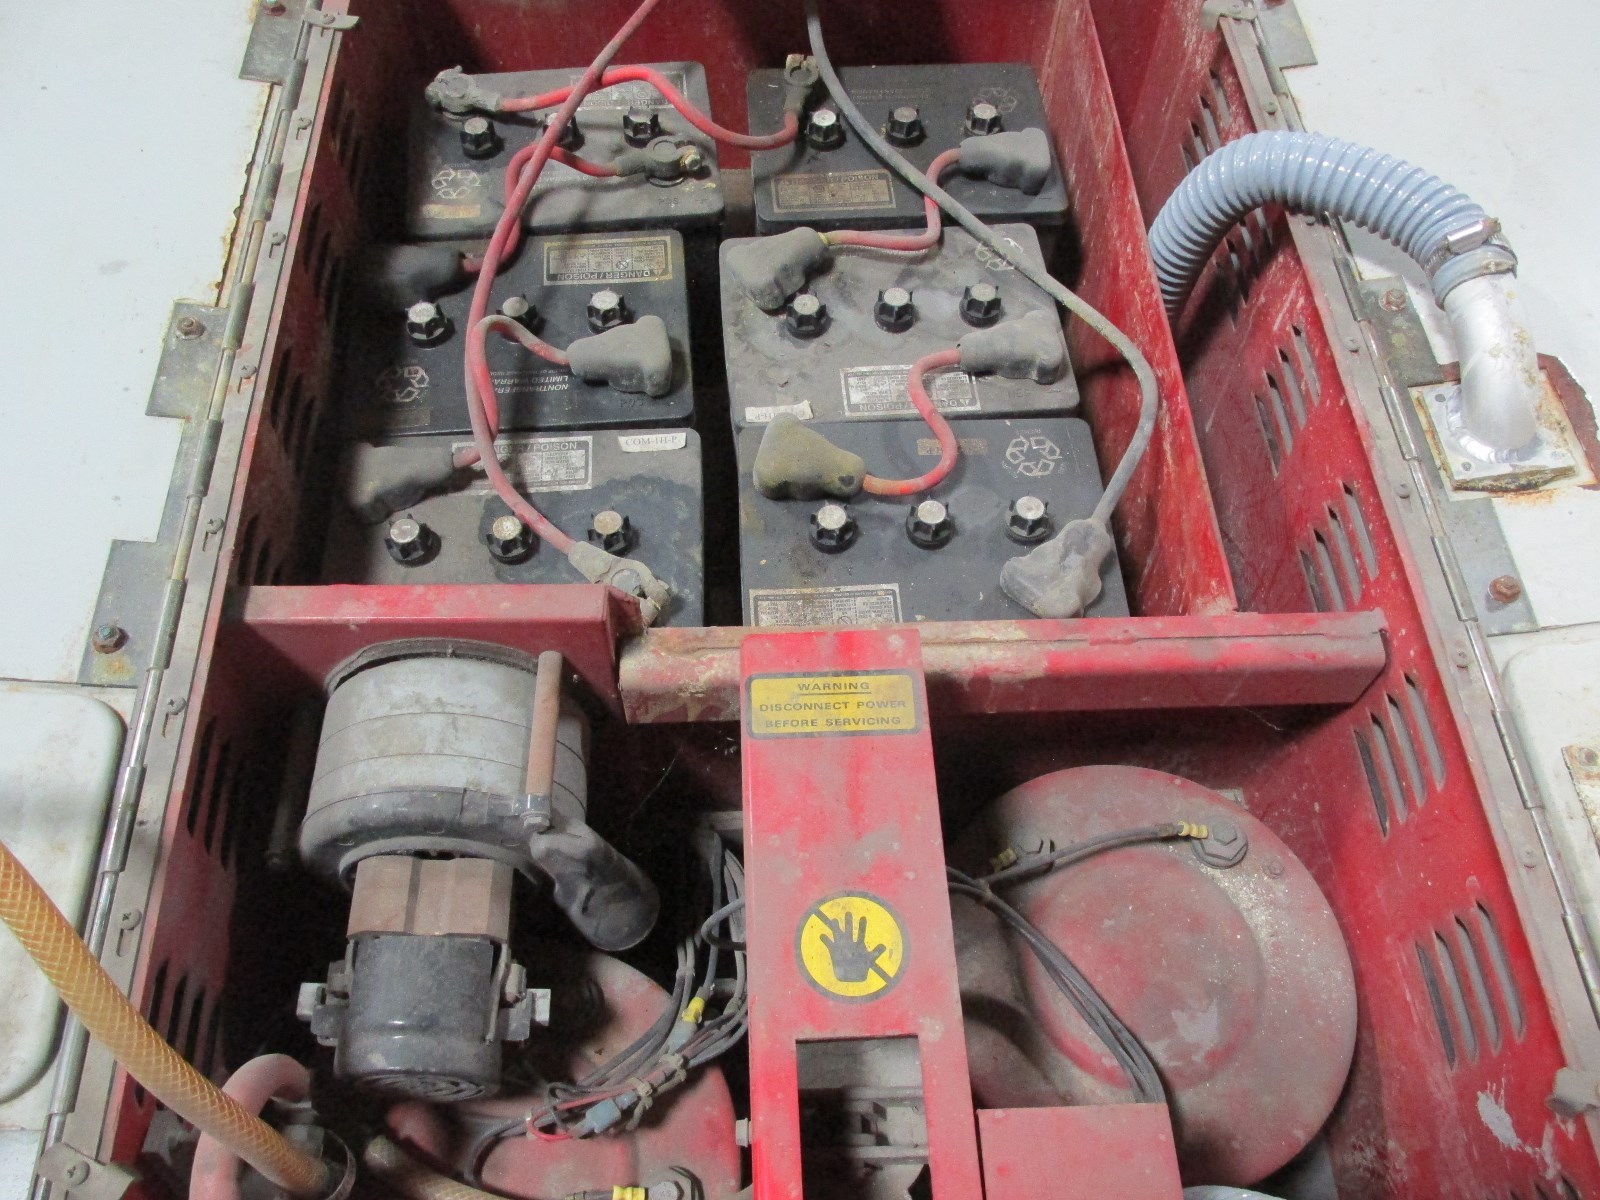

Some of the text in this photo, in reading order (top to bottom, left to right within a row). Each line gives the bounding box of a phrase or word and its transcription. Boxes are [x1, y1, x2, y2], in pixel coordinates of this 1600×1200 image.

[797, 681, 870, 691] WARNING
[758, 701, 850, 712] DISCONNECT
[856, 700, 906, 709] POWER
[765, 718, 818, 728] BEFORE
[825, 716, 901, 727] SERVICING
